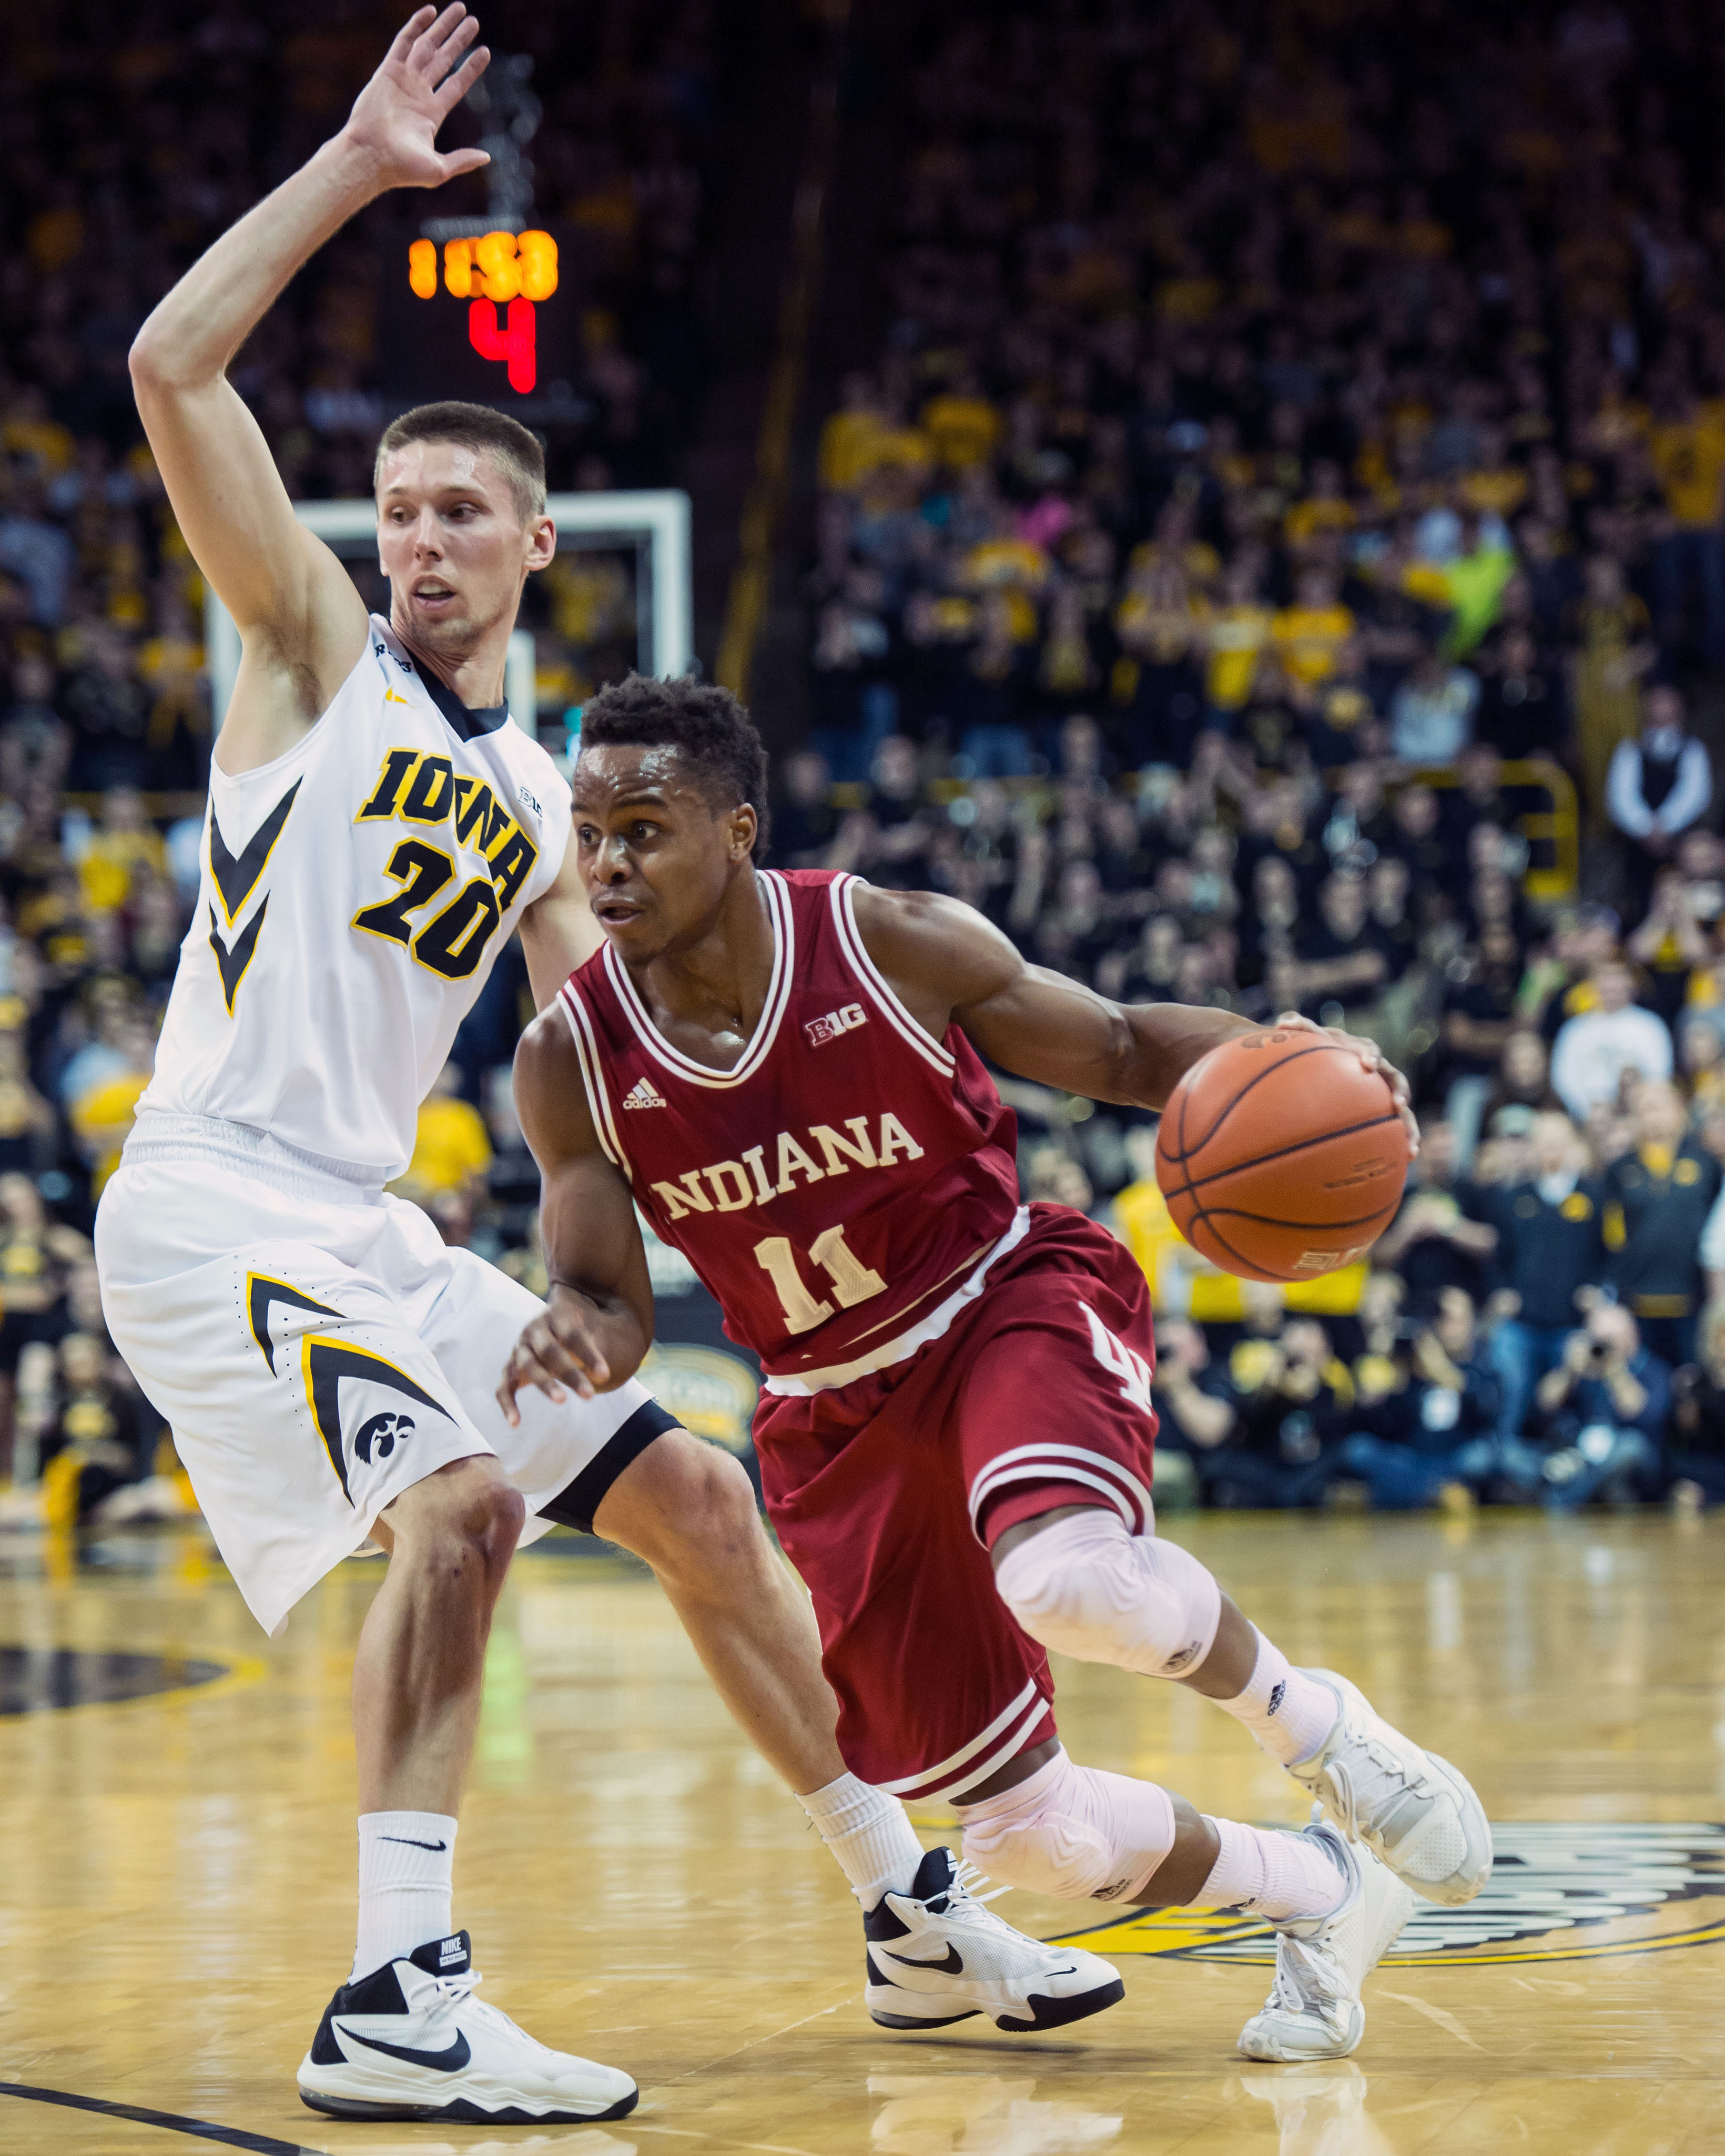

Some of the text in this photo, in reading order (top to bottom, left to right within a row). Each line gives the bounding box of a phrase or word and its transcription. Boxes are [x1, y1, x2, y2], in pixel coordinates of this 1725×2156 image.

[469, 297, 536, 394] 4
[353, 747, 540, 915] IOWA
[350, 836, 501, 981] 20
[623, 1096, 667, 1110] adidas
[649, 1112, 925, 1221] NDIANA
[753, 1224, 889, 1335] 11
[441, 1936, 462, 1956] NIKE
